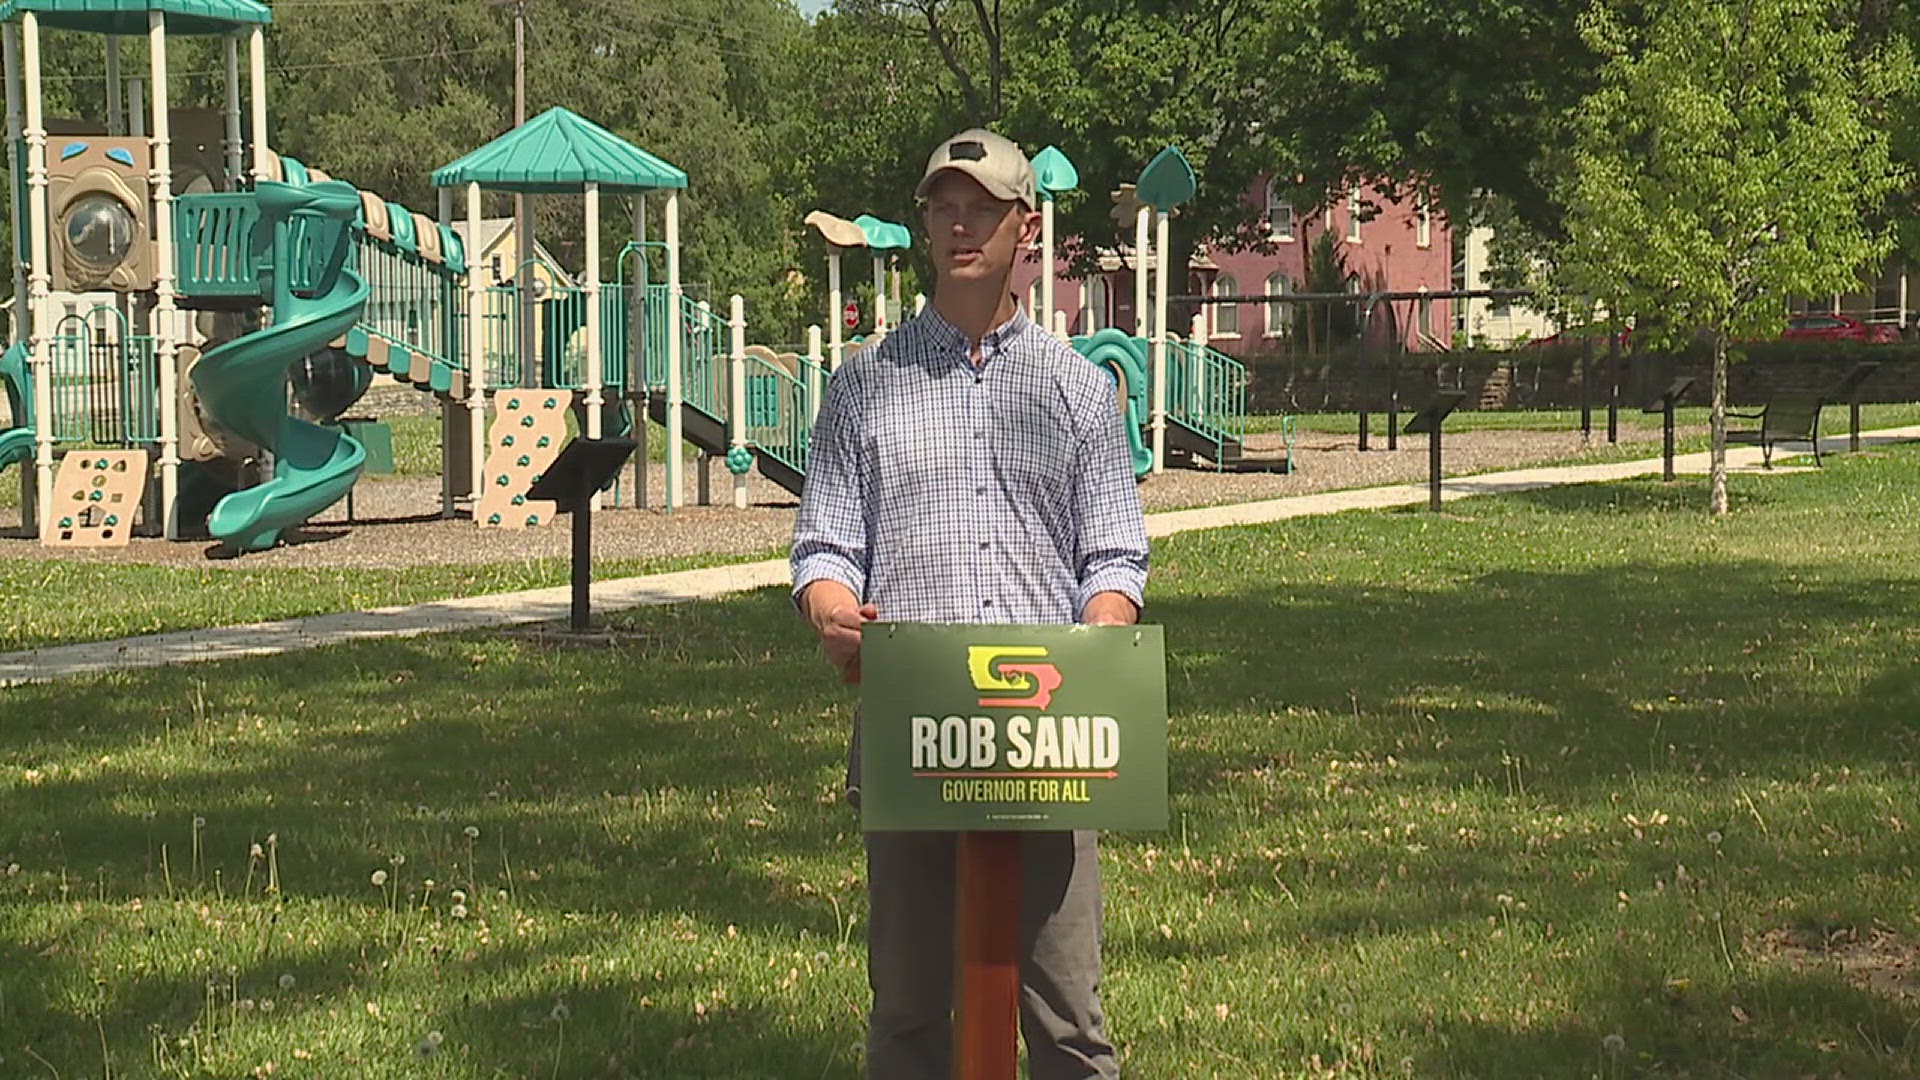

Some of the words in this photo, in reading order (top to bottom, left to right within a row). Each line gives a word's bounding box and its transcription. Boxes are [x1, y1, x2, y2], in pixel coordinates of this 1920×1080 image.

[911, 716, 996, 768] ROB
[1006, 716, 1120, 769] SAND
[942, 780, 1025, 802] GOVERNOR
[1029, 780, 1058, 802] FOR
[1062, 780, 1090, 802] ALL
